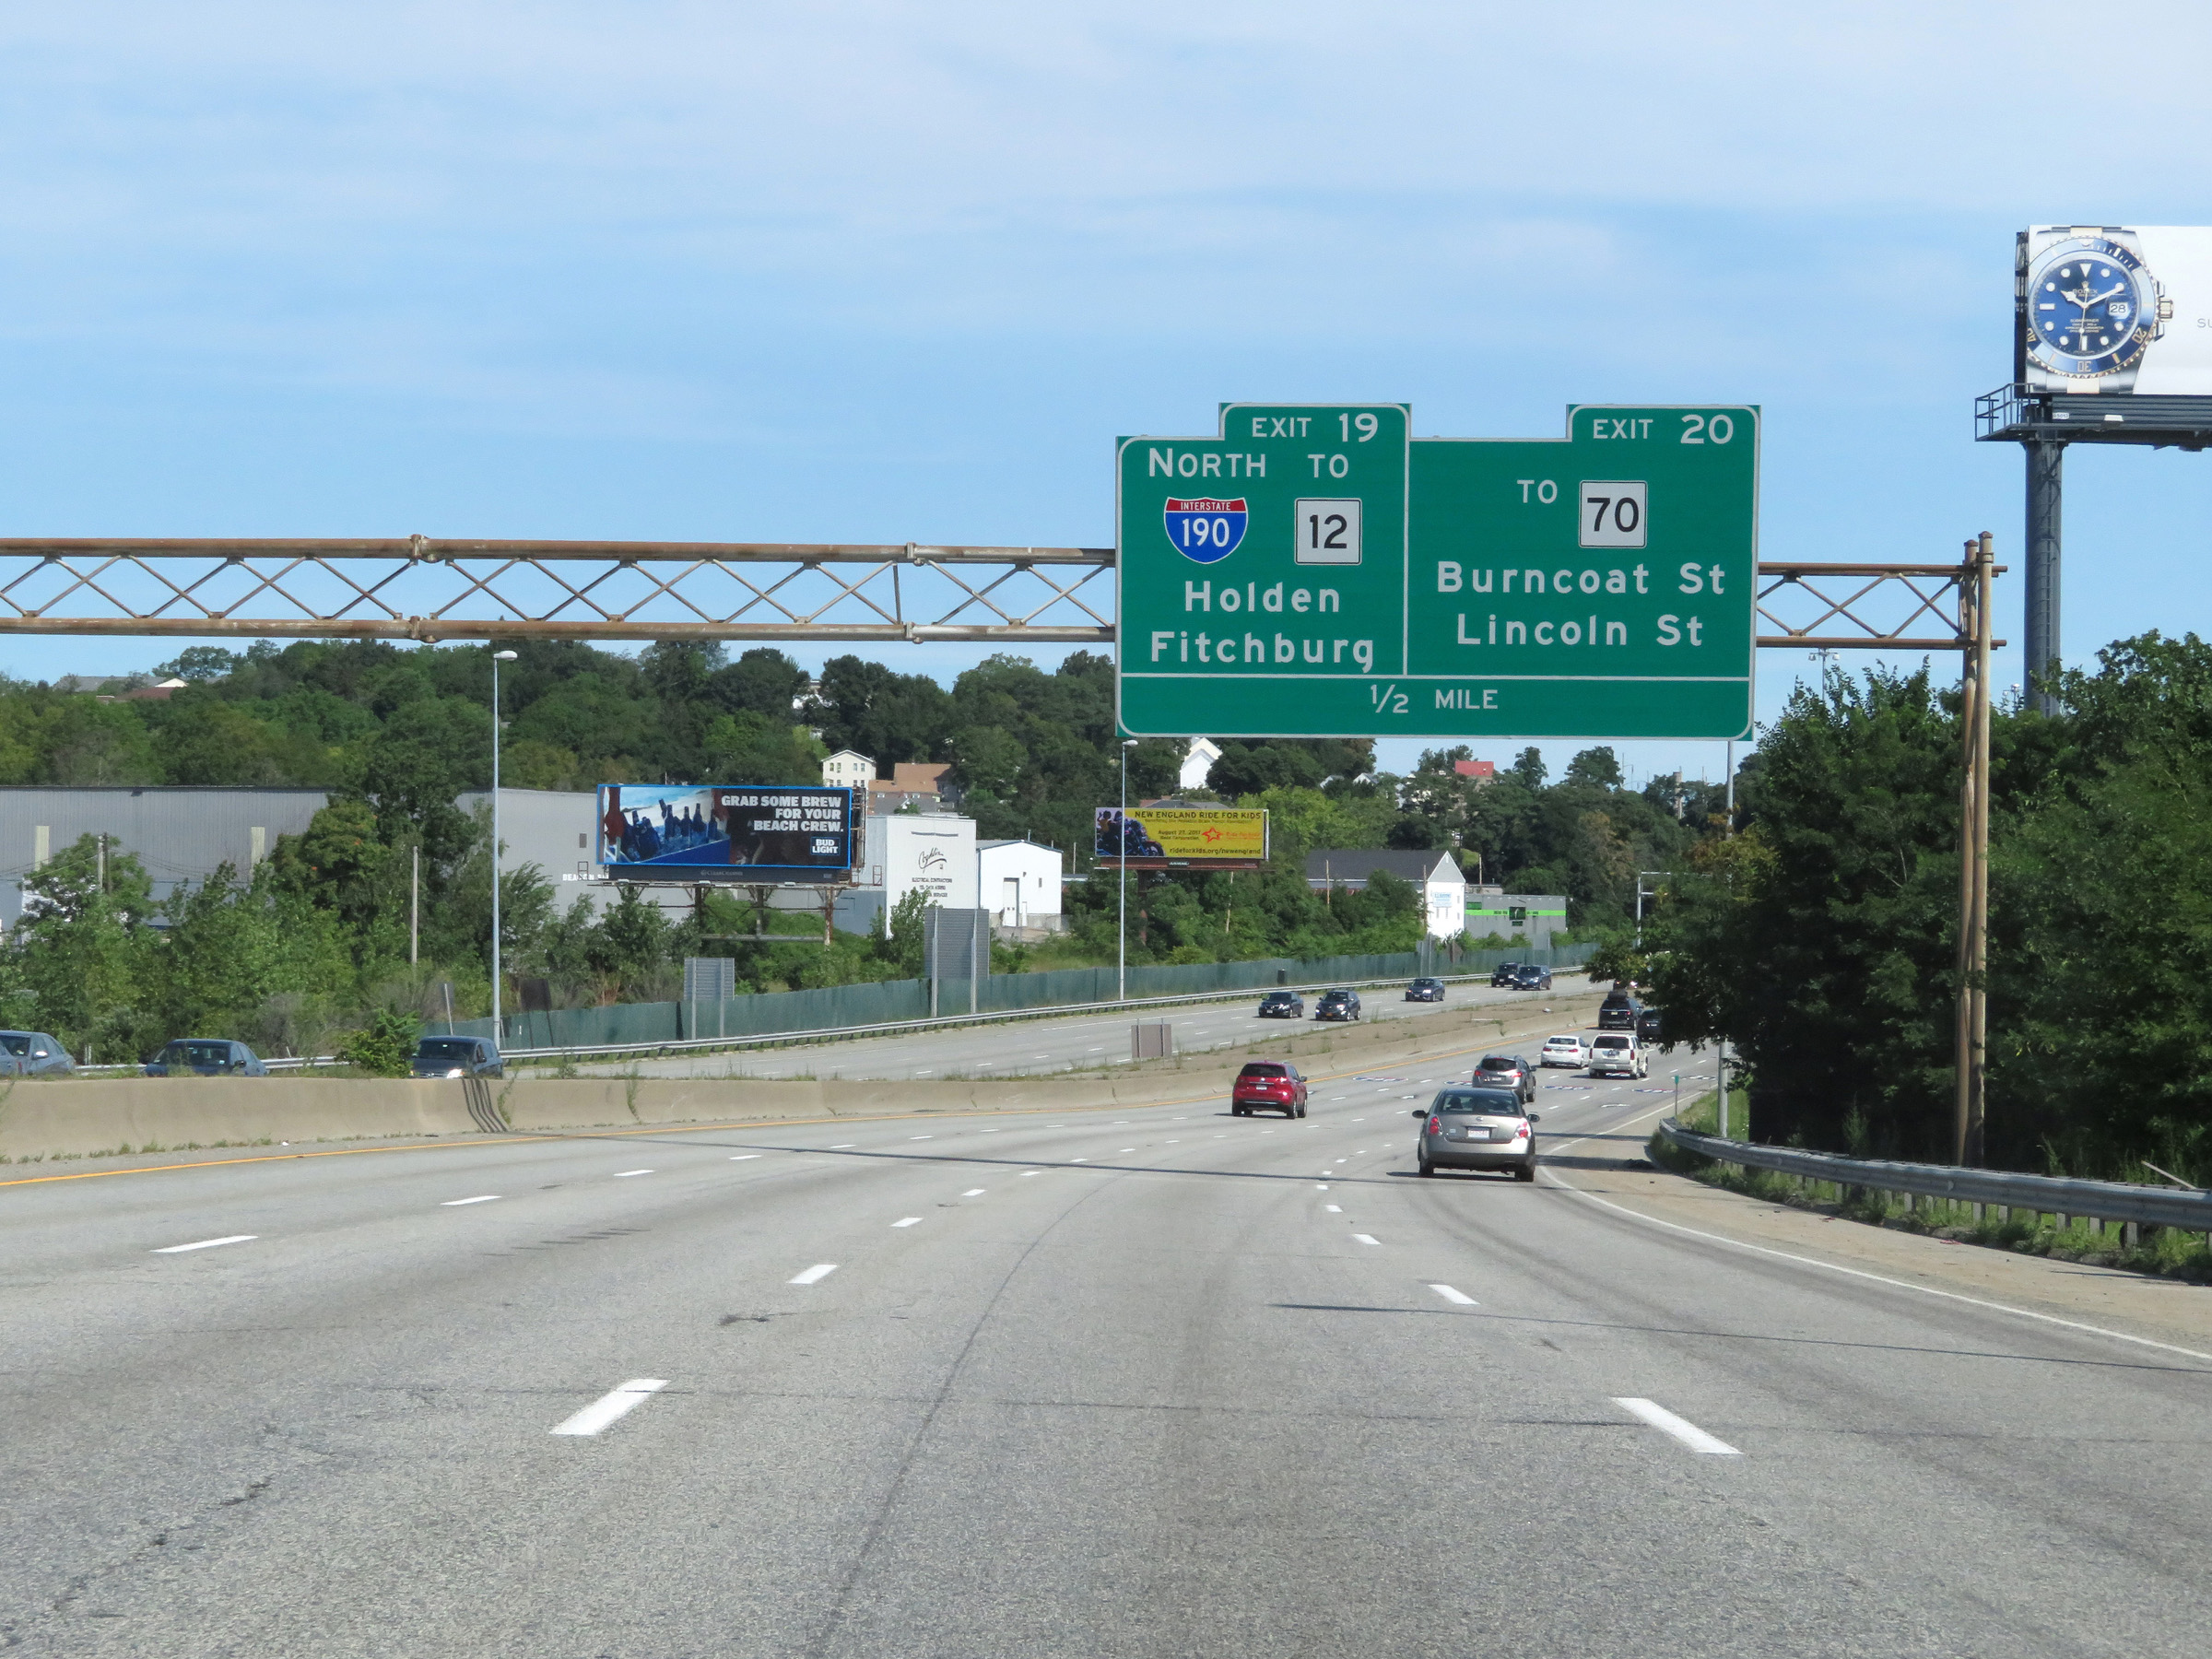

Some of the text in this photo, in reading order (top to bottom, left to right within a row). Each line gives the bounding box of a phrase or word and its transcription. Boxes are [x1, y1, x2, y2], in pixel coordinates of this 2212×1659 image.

[2110, 304, 2126, 313] 28
[1252, 413, 1379, 442] EXIT 19
[1593, 415, 1734, 445] EXIT 20
[1148, 447, 1349, 478] NORTH TO
[1516, 479, 1559, 504] TO
[1180, 500, 1231, 512] INTERSTATE
[1586, 497, 1640, 533] 70
[1182, 517, 1230, 548] 190
[1309, 513, 1347, 549] 12
[1437, 560, 1725, 595] Burncoat St
[1184, 581, 1340, 613] Holden
[1457, 614, 1703, 647] Lincoln St
[1151, 630, 1374, 674] Fitchburg
[1435, 688, 1499, 710] MILE
[721, 795, 842, 807] GRAB SOME BREW
[775, 808, 841, 819] FOR YOUR
[1135, 810, 1154, 819] NEW
[1156, 811, 1197, 819] ENGLAND
[1199, 811, 1218, 819] RIDE
[1221, 811, 1239, 819] FOR
[753, 820, 844, 832] BEACH CREW.
[812, 846, 839, 854] LIGHT
[816, 839, 835, 847] BUD
